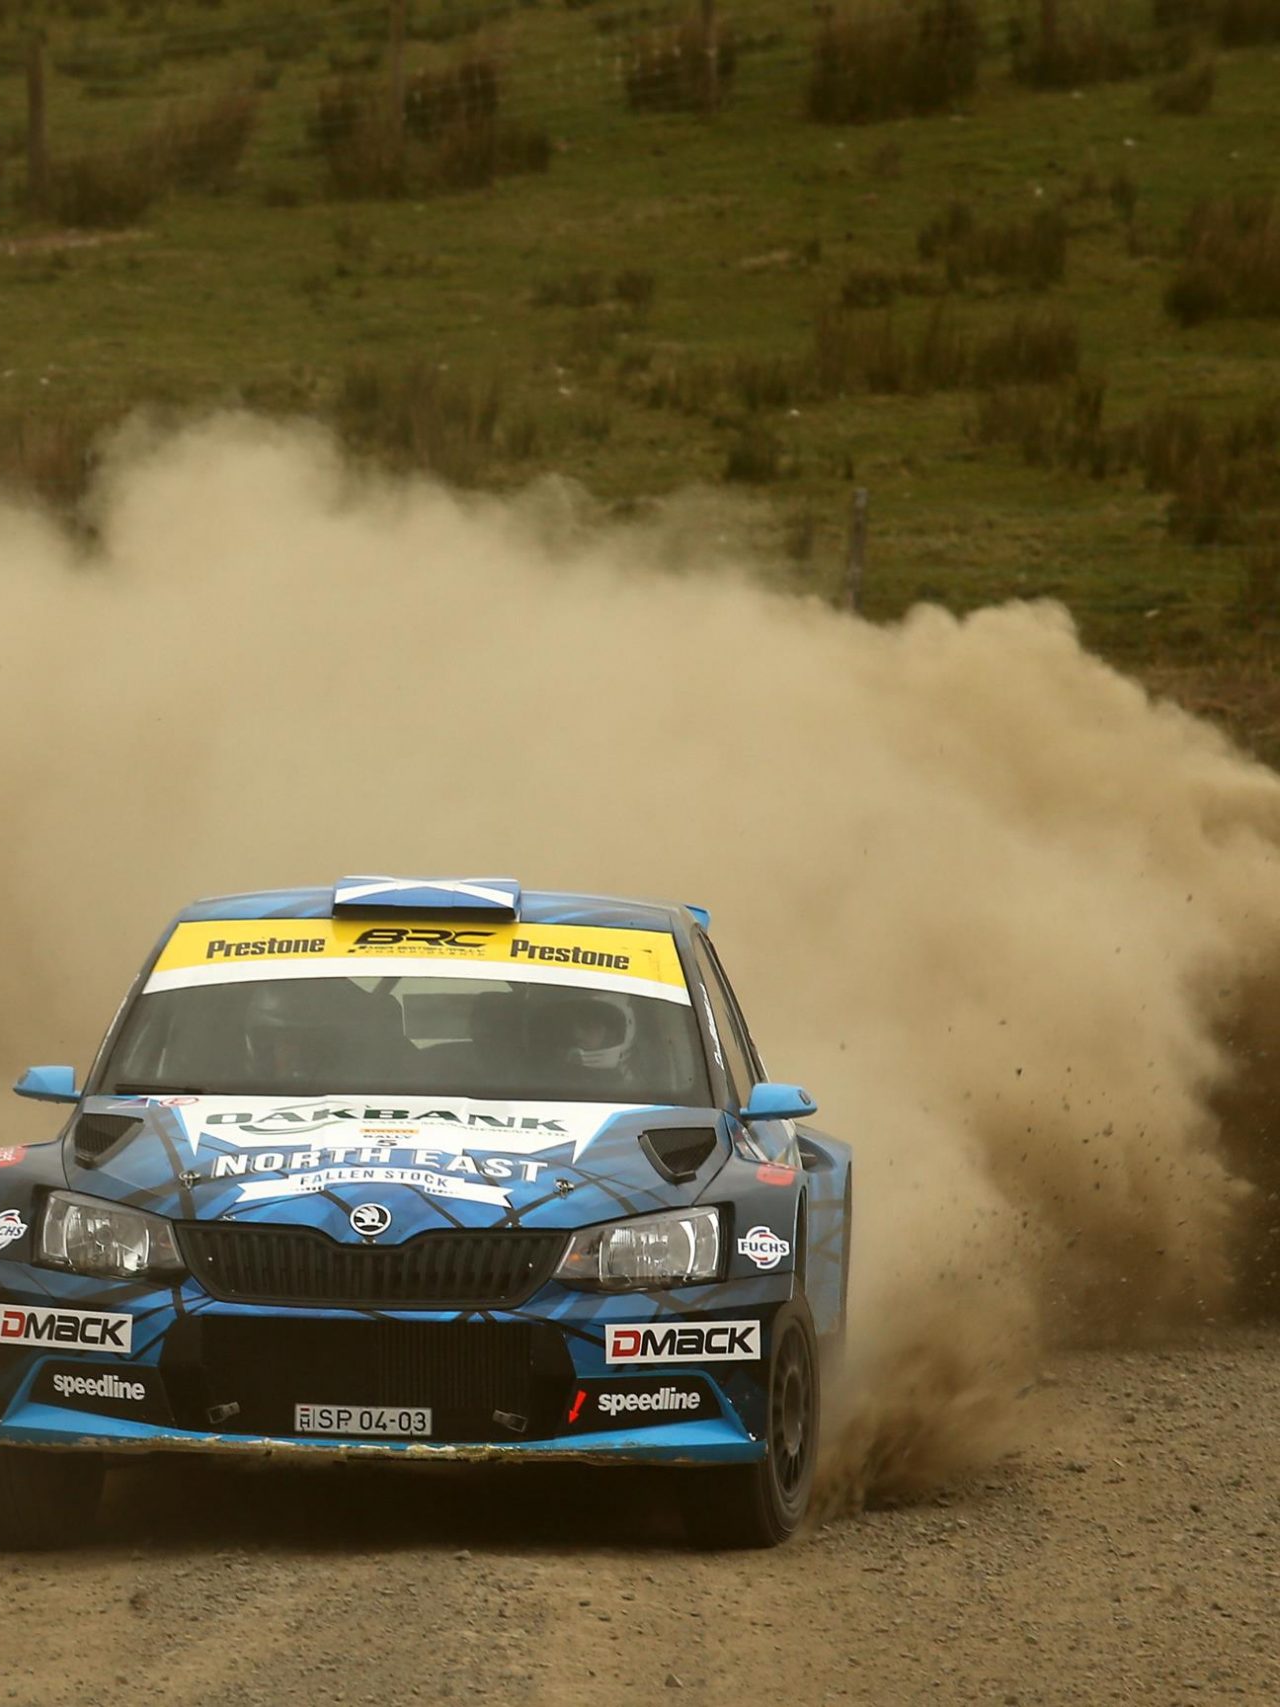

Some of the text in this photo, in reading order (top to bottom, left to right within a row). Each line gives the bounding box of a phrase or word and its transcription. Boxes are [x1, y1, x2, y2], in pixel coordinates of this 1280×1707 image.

[206, 937, 326, 959] Prestone
[353, 928, 497, 948] BRC
[510, 938, 630, 970] Prestone
[206, 1108, 569, 1132] OAKBANK
[211, 1147, 548, 1183] NORTH EAST
[300, 1169, 449, 1188] FALLEN STOCK
[740, 1241, 788, 1255] FUCHS
[53, 1373, 146, 1401] speedline
[598, 1387, 701, 1417] speedline
[318, 1408, 427, 1432] SP 04-03
